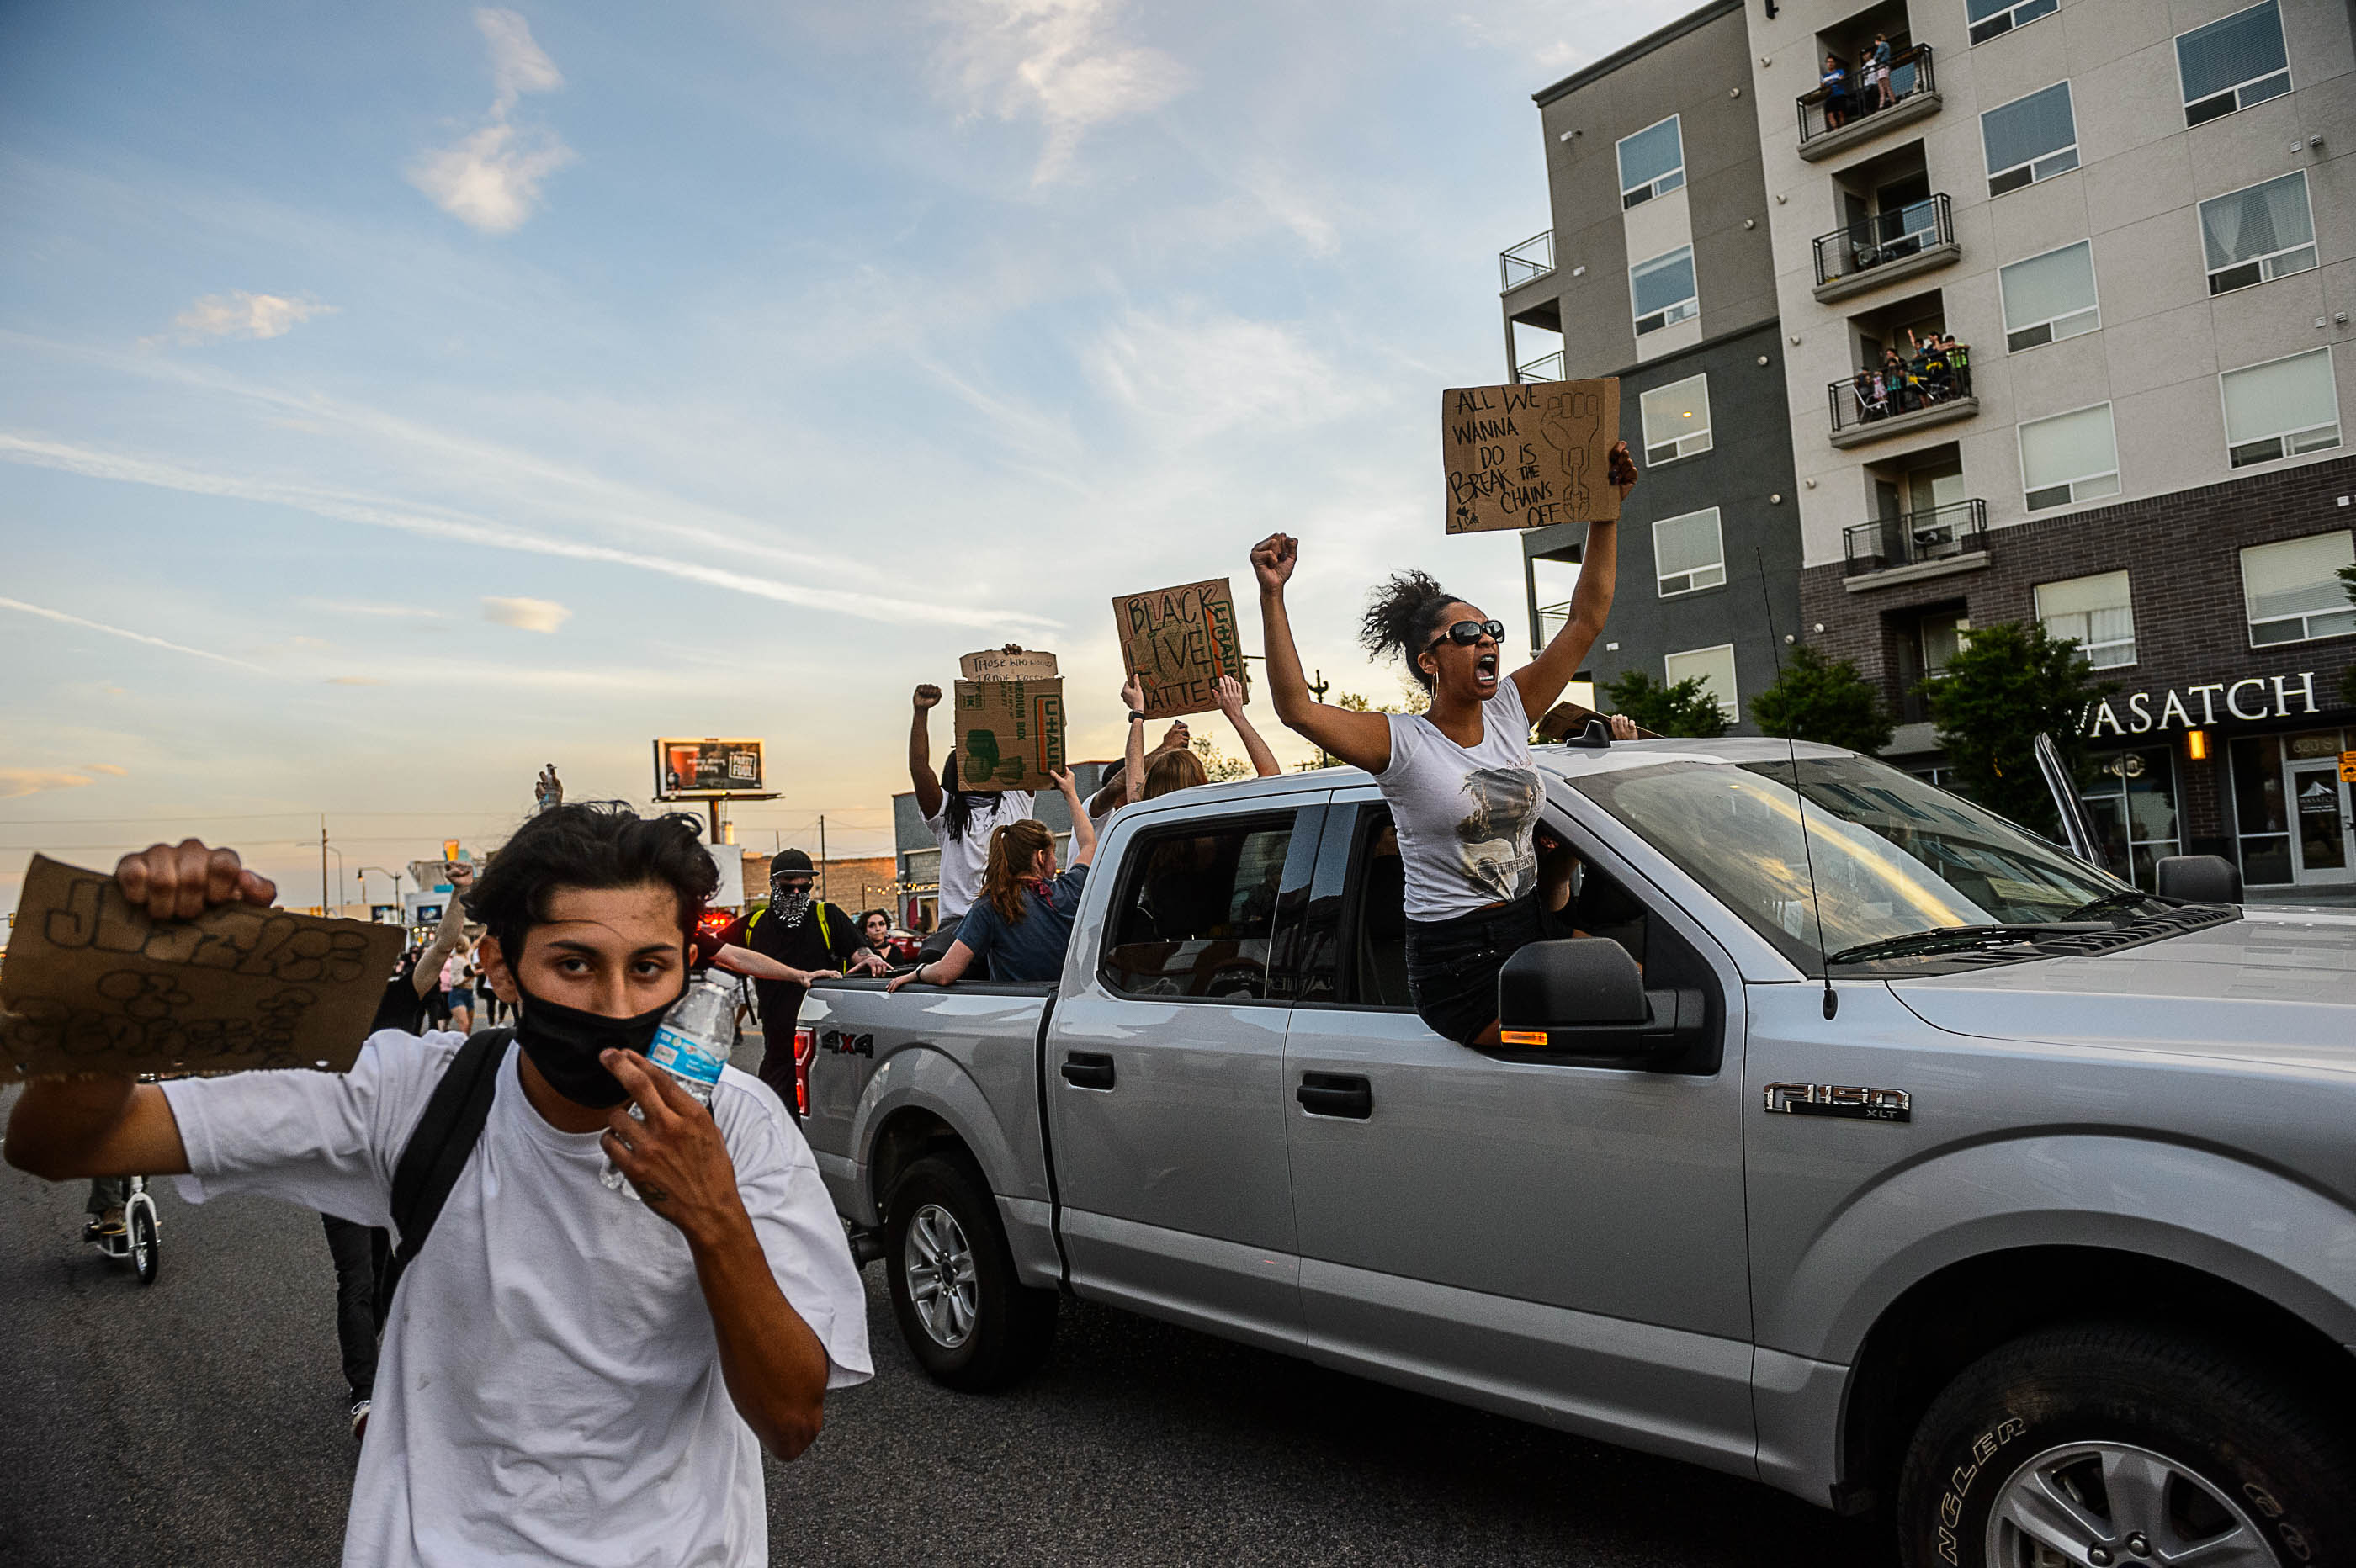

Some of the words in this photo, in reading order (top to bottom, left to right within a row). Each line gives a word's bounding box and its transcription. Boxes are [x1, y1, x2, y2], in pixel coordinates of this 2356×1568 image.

[1455, 390, 1495, 415] ALL
[1501, 384, 1540, 414] WE
[1452, 417, 1519, 445] WANNA
[1480, 445, 1505, 469] DO
[1520, 443, 1537, 464] IS
[1449, 469, 1515, 505] BREAK
[1516, 464, 1540, 481] THE
[1500, 481, 1553, 514] CHAINS
[1527, 502, 1561, 527] OFF
[1128, 588, 1218, 634] BLACK
[971, 657, 1006, 673] THOSE
[1010, 657, 1027, 667] WHO
[2075, 672, 2320, 738] ASATCH
[1016, 722, 1027, 741] BOX
[1865, 1108, 1898, 1120] XLT
